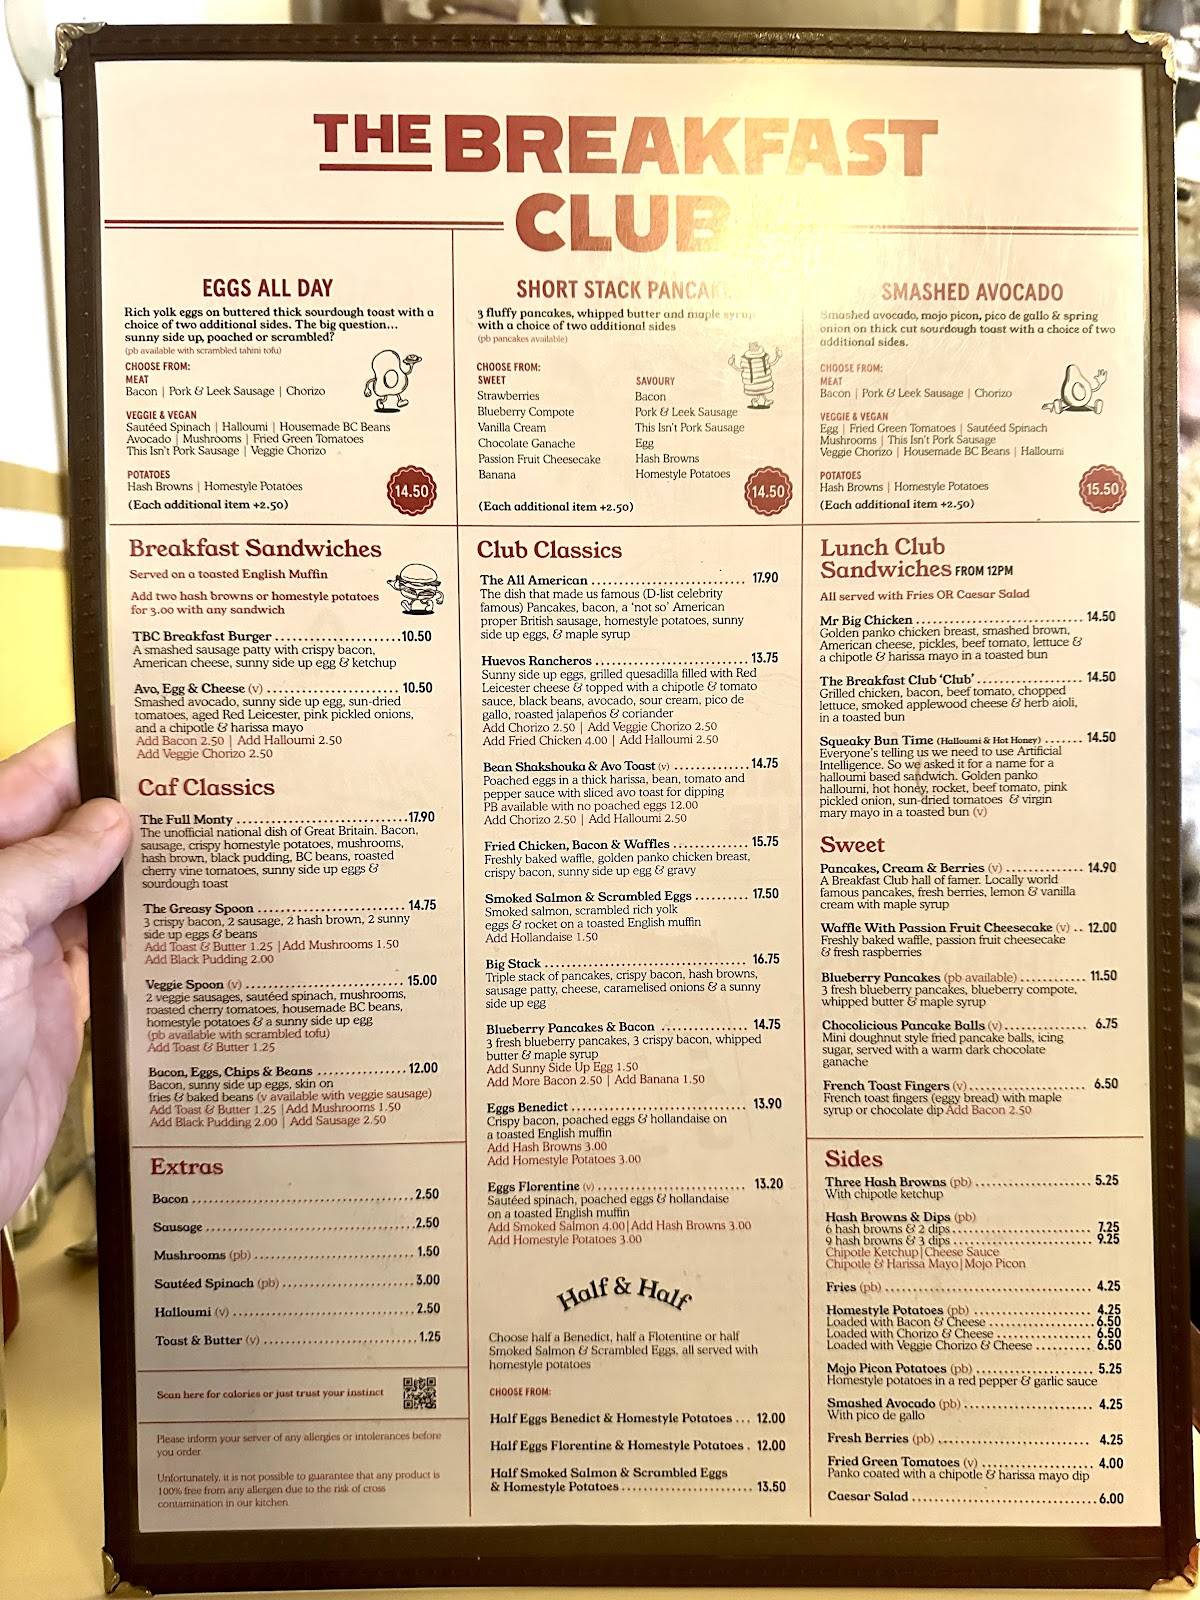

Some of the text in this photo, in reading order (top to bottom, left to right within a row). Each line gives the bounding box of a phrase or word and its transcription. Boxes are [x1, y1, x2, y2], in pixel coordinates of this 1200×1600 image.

[313, 113, 938, 176] THE BREAKFAST
[516, 192, 732, 254] CLUB
[203, 278, 333, 297] EGGS ALL DAY
[516, 279, 641, 299] SHORT STACK
[882, 282, 1063, 301] SMASHED AVOCADO
[124, 307, 150, 317] Rich
[153, 307, 177, 320] yolk
[179, 309, 204, 320] eggs
[206, 309, 220, 317] on
[222, 306, 270, 317] buttered
[273, 306, 304, 317] thick
[304, 307, 364, 320] sourdough
[367, 308, 395, 317] toast
[398, 307, 424, 317] with
[125, 361, 190, 371] CHOOSE FROM:
[126, 375, 148, 384] MEAT
[477, 390, 540, 401] Strawberries
[477, 406, 574, 419] Blueberry Compote
[478, 422, 546, 432] Vanilla Cream
[478, 469, 516, 480] Banana
[394, 484, 430, 498] 14.50
[750, 486, 786, 498] 14.50
[1086, 482, 1120, 496] 15.50
[128, 499, 289, 511] (Each additional item +2.50)
[129, 537, 382, 558] Breakfast Sandwiches
[477, 540, 622, 559] Club Classics
[820, 536, 945, 557] Lunch Club
[129, 569, 169, 579] Served
[188, 571, 195, 579] a
[198, 569, 239, 579] toasted
[242, 568, 286, 581] English
[289, 568, 328, 579] Muffin
[820, 559, 1013, 579] Sandwiches FROM 12PM
[479, 571, 779, 586] The All American 17.90
[820, 610, 1116, 628] Mr Big Chicken 14.50
[132, 630, 432, 644] TBC Breakfast Burger 10.50
[481, 652, 778, 666] Huevos Rancheros 13.75
[134, 681, 433, 696] Avo, Egg & Cheese (v) 10.50
[138, 777, 275, 797] Caf Classics
[139, 811, 435, 827] The Full Monty 17.90
[484, 835, 779, 852] Fried Chicken, Bacon & Waffles 15.75
[820, 836, 885, 853] Sweet
[820, 861, 1117, 875] Pancakes, Cream & Berries (v) 14.90
[485, 887, 779, 904] Smoked Salmon & Scrambled Eggs 17.50
[486, 953, 780, 972] Big Stack 16.75
[821, 969, 1117, 985] Blueberry Pancakes (pb available) 11.50
[148, 1062, 438, 1080] Bacon, Eggs, Chips & Beans 12.00
[487, 1097, 782, 1115] Eggs Benedict 13.90
[151, 1158, 224, 1175] Extras
[824, 1149, 883, 1168] Sides
[152, 1188, 439, 1204] Bacon 2.50
[153, 1216, 440, 1234] Sausage 2.50
[154, 1245, 440, 1262] Mushrooms (pb) 1.50
[154, 1274, 440, 1291] Sautéed Spinach (pb) 3.00
[826, 1280, 1121, 1294] Fries (pb) 4.25
[556, 1276, 692, 1312] Half & Half
[155, 1330, 441, 1346] Toast & Butter (v) 1.25
[157, 1390, 181, 1399] Scan
[183, 1390, 204, 1399] here
[206, 1389, 221, 1399] for
[222, 1389, 261, 1398] calories
[275, 1390, 293, 1400] just
[322, 1390, 345, 1399] your
[347, 1388, 384, 1397] instinct
[489, 1387, 552, 1396] CHOOSE FROM:
[827, 1490, 1124, 1504] Caesar Salad 6.00
